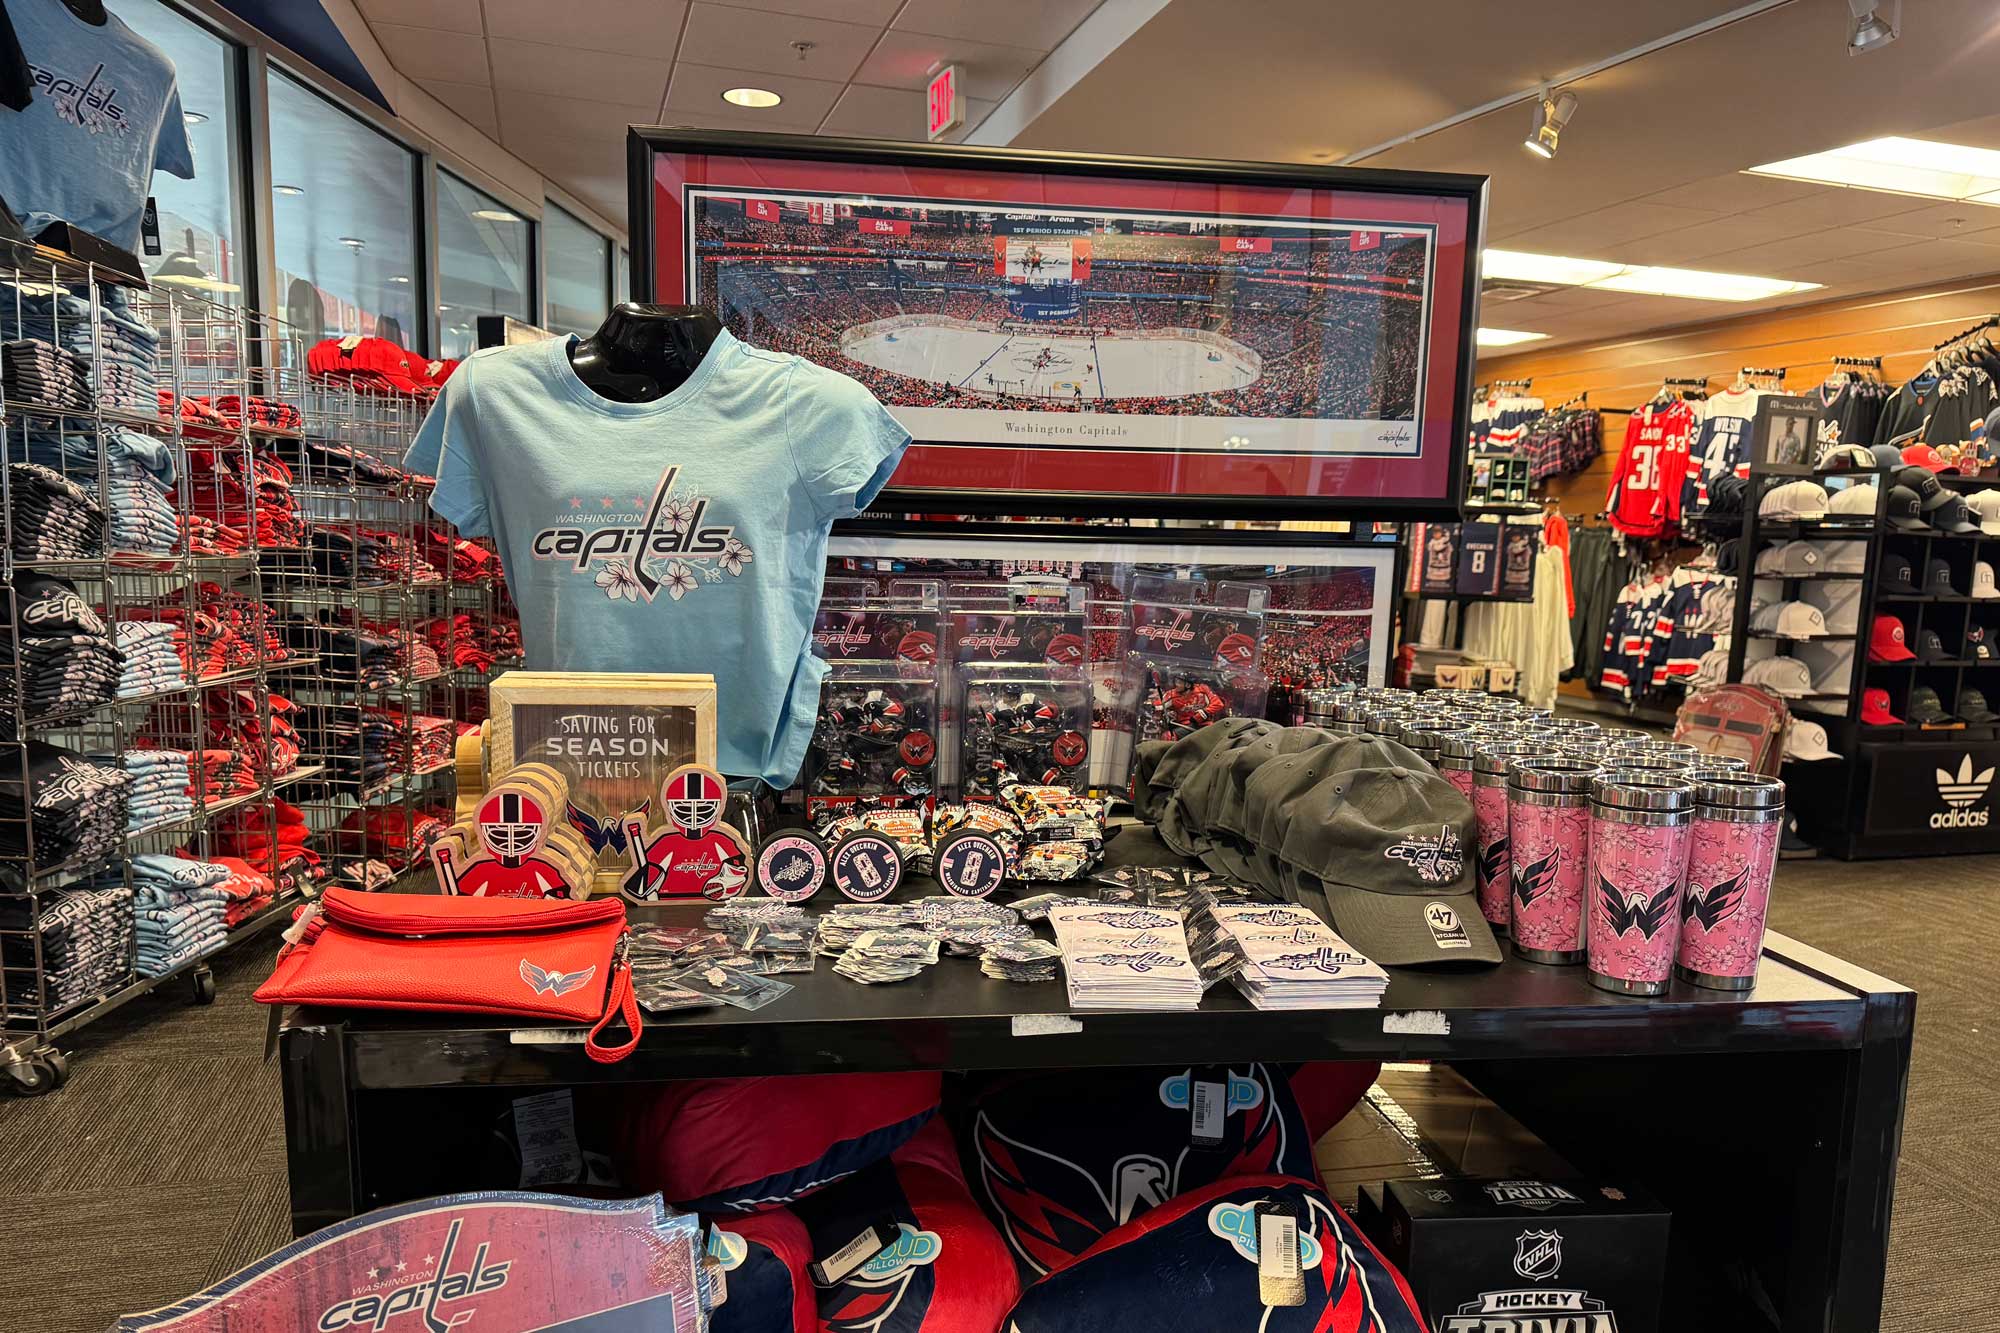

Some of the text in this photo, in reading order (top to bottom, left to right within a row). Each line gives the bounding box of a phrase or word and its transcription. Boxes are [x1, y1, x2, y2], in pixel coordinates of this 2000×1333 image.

[1005, 422, 1128, 438] Washington Capitals
[555, 513, 644, 525] WASHINGTON
[533, 465, 734, 601] capitals
[1471, 551, 1486, 574] 8
[959, 617, 1021, 659] capitals
[1135, 611, 1196, 651] capitals
[560, 716, 656, 734] SAVING FOR
[546, 737, 669, 757] SEASON
[577, 760, 641, 779] TICKETS
[1929, 808, 1989, 829] adidas
[839, 842, 879, 867] ALEX OVECHKIN
[957, 841, 997, 861] ALEX OVECHKIN
[852, 852, 882, 888] 8
[882, 866, 896, 889] CAPITALS
[960, 850, 984, 887] 8
[970, 880, 993, 895] CAPITALS
[1487, 1185, 1576, 1201] TRIVIA
[865, 1257, 908, 1272] PILLOW
[1523, 1243, 1554, 1271] NHL
[318, 1217, 514, 1333] capitals
[351, 1269, 434, 1296] WASHINGTON
[1495, 1293, 1573, 1308] HOCKEY
